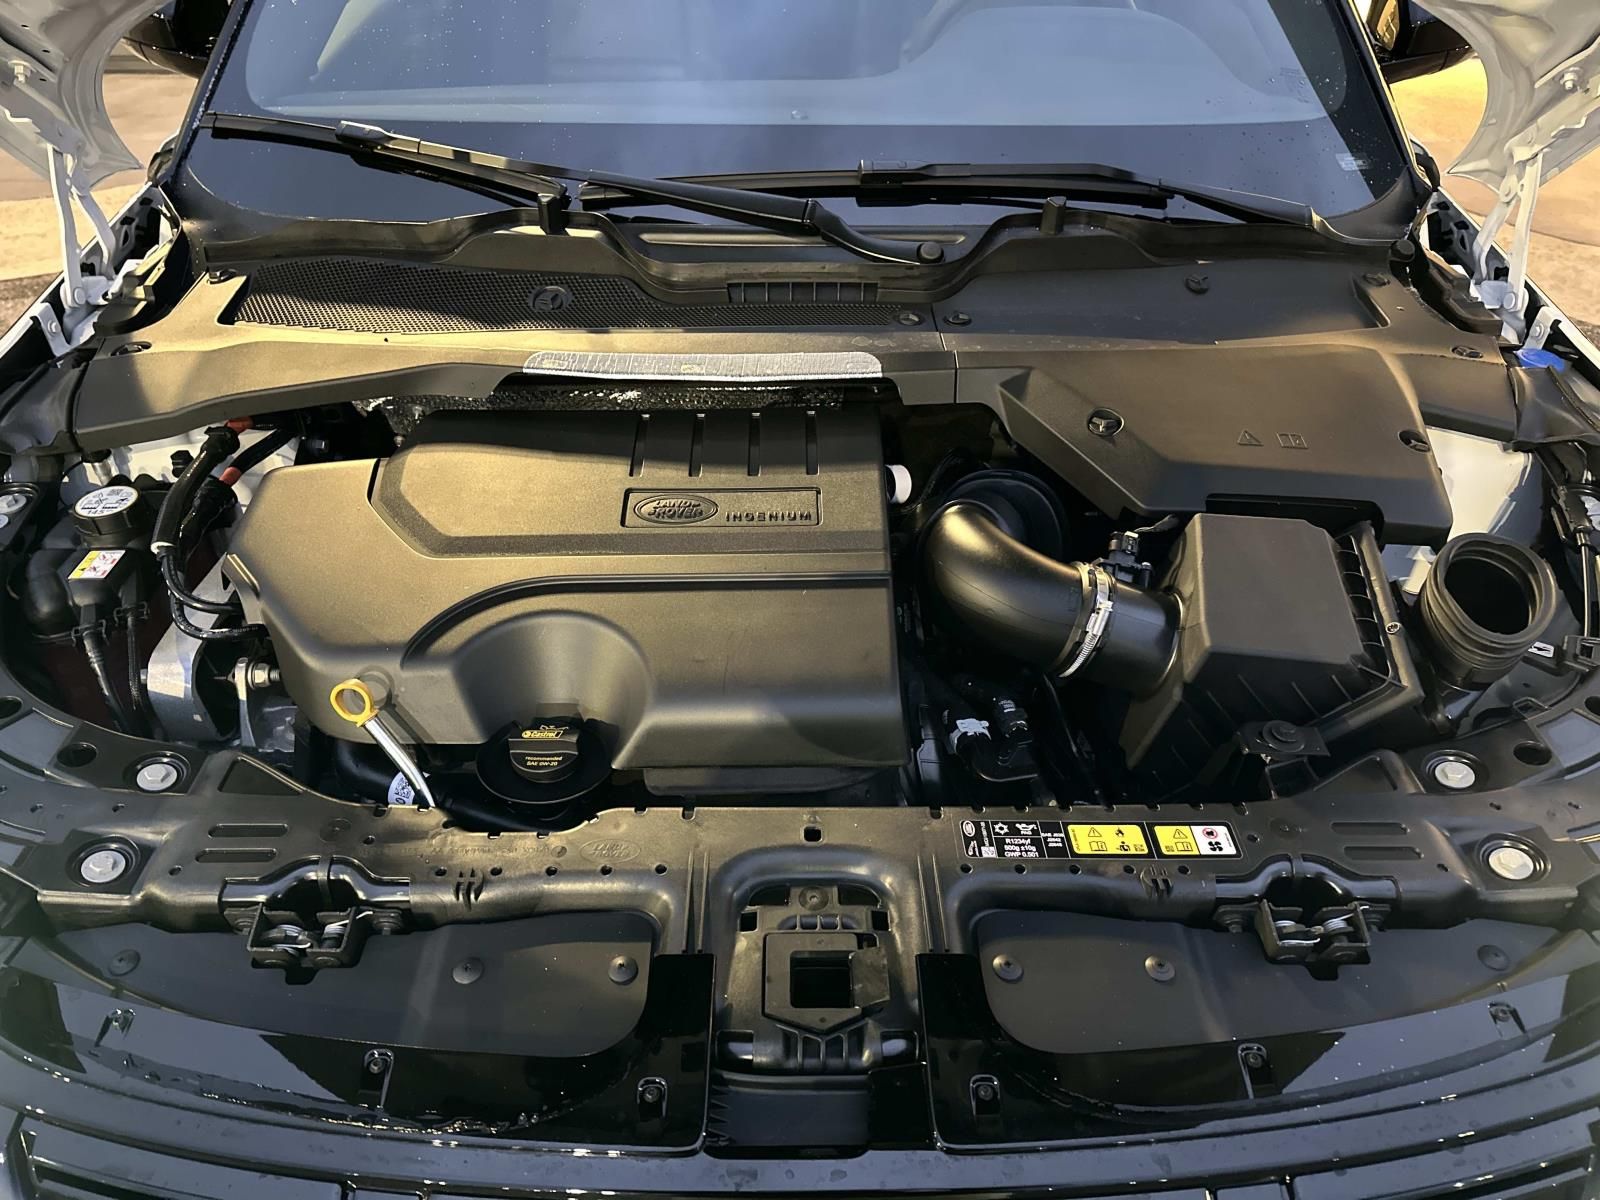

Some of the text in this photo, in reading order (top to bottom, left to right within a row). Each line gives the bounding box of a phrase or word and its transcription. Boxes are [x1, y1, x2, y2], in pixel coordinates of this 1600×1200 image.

[653, 500, 693, 508] LAND
[655, 508, 703, 519] ROVER
[725, 511, 812, 522] INGENIUM
